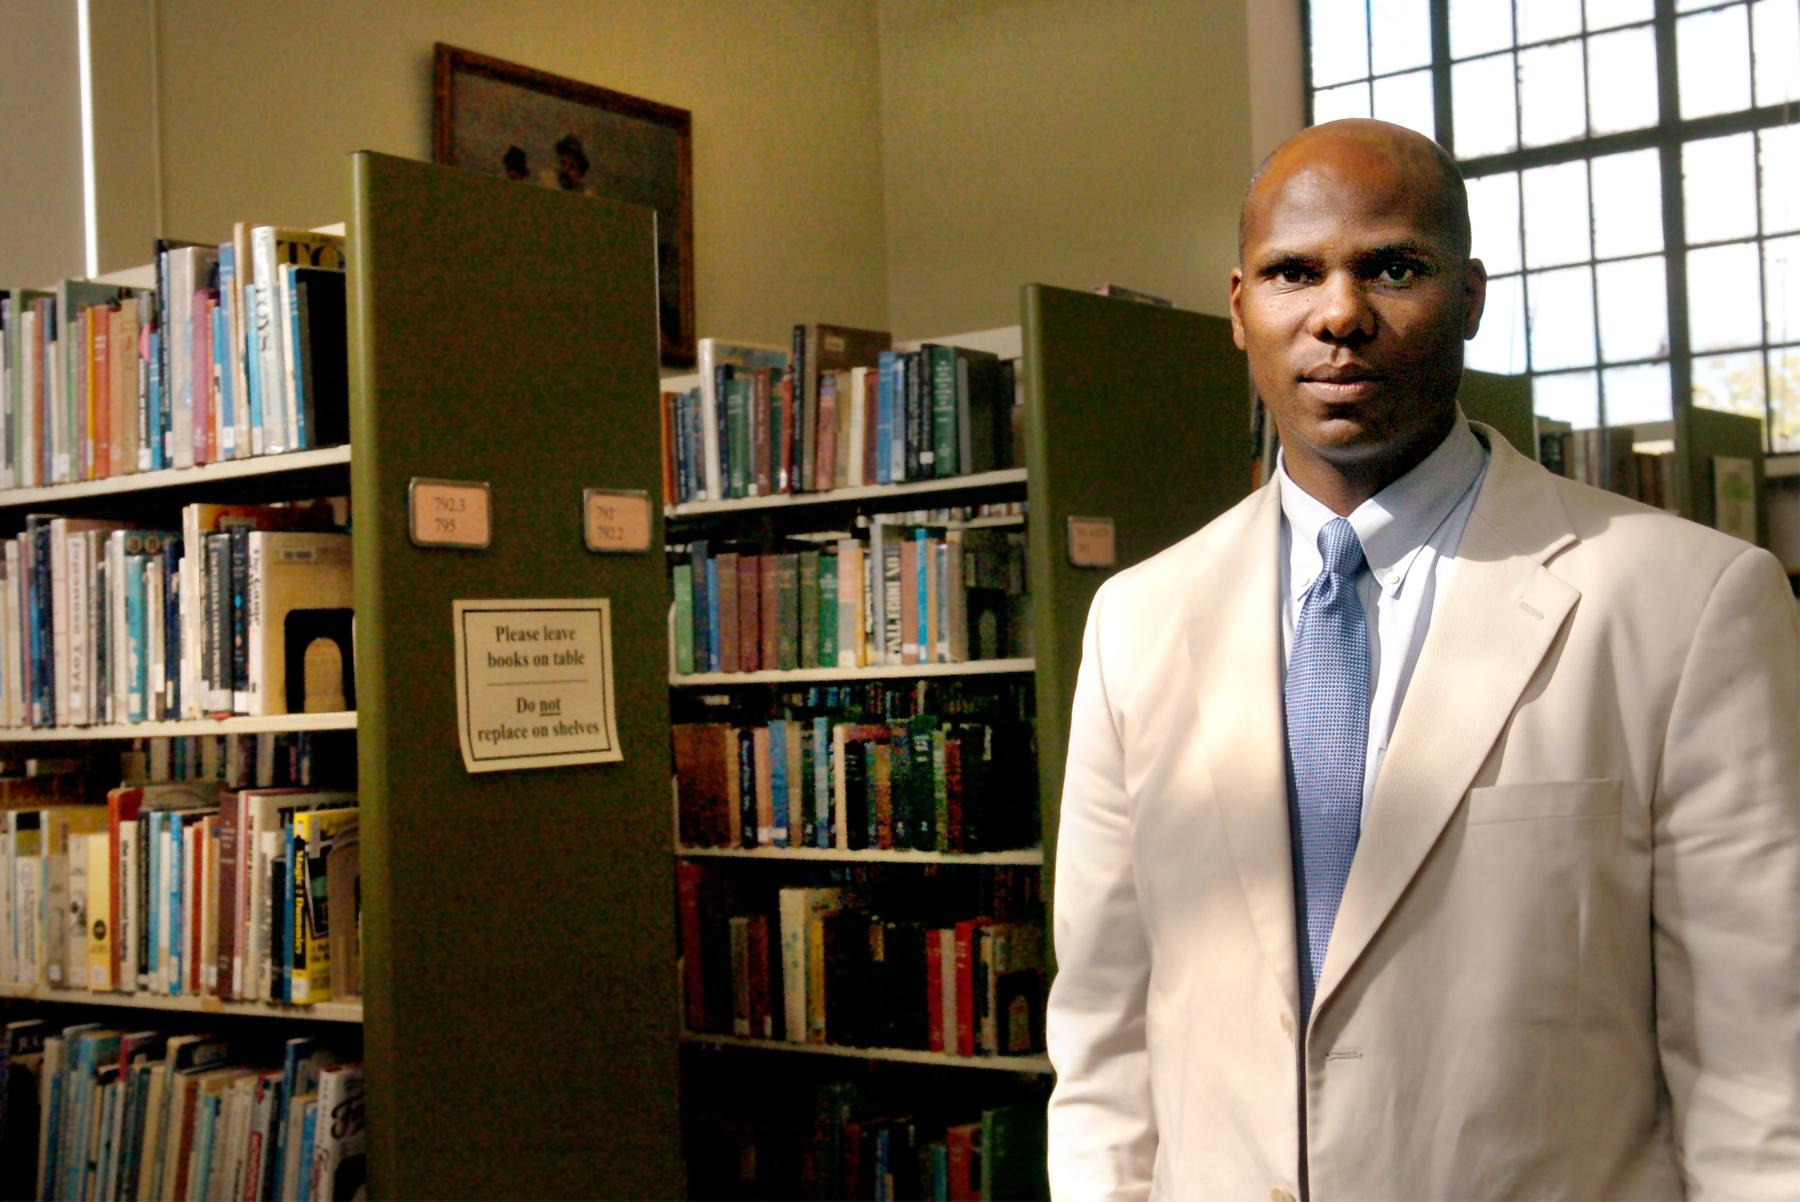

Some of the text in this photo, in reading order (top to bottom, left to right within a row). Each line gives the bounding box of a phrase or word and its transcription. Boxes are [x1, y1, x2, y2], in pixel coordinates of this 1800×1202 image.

[495, 625, 576, 643] Please leave
[487, 649, 585, 668] books on table
[516, 697, 562, 716] Do not
[477, 719, 600, 745] replace on shelves
